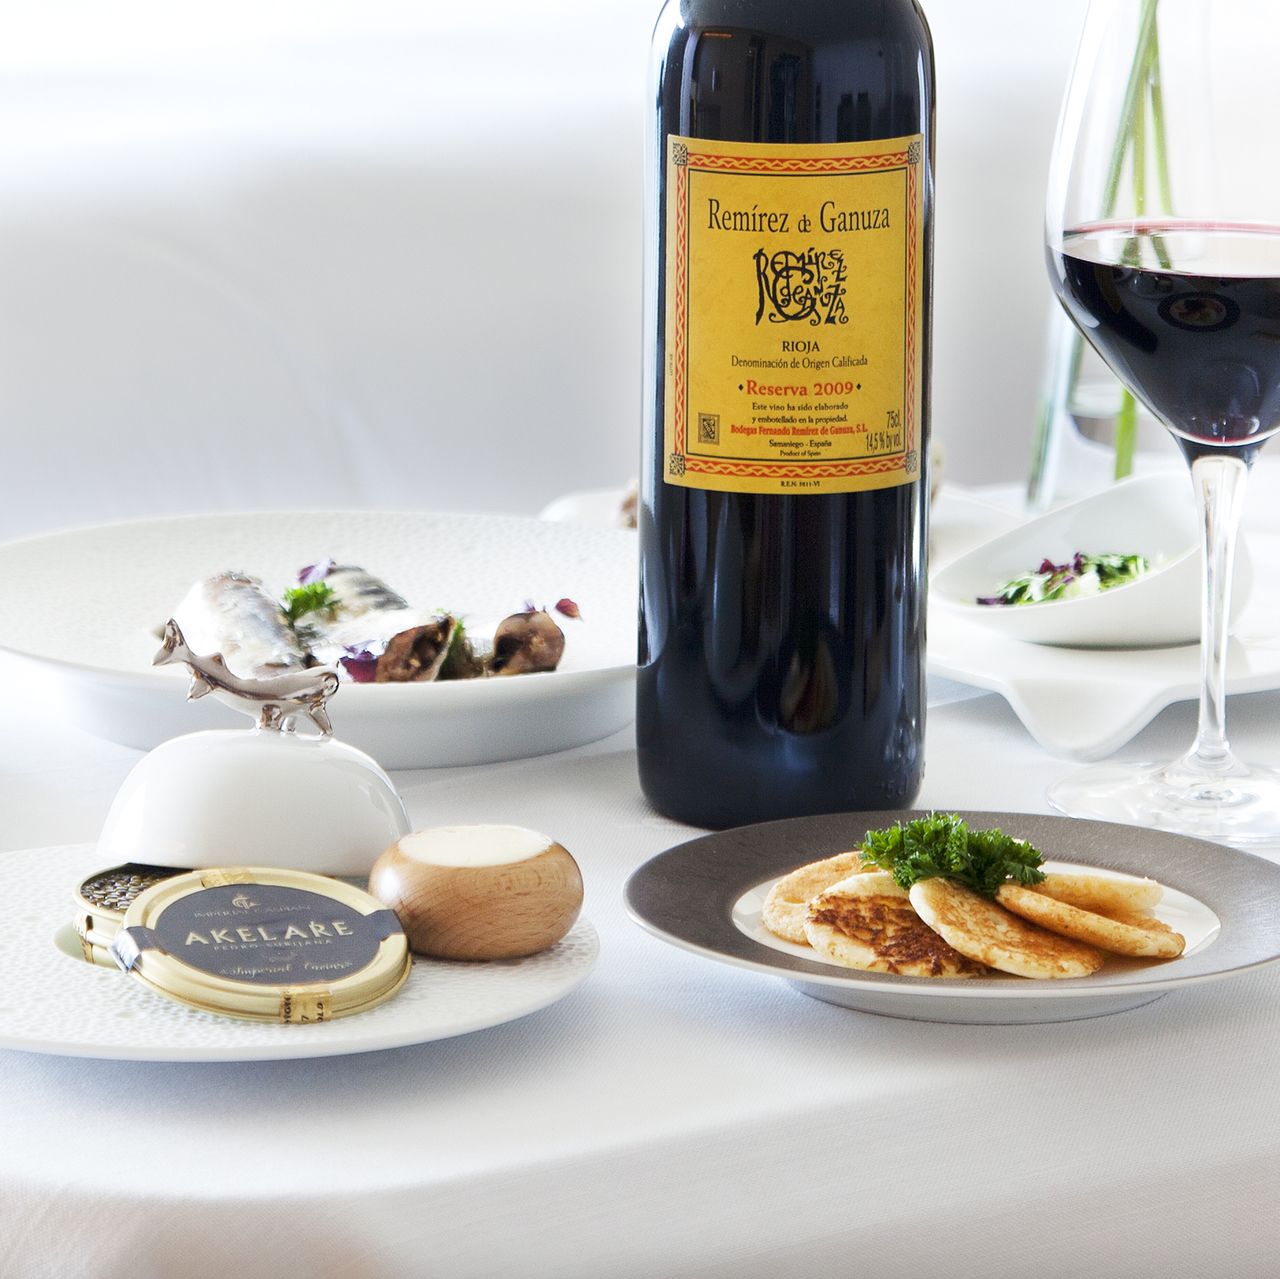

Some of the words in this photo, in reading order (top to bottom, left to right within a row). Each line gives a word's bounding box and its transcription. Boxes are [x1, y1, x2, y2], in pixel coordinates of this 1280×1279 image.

[708, 198, 789, 233] Remírez
[797, 214, 812, 233] de
[820, 201, 890, 233] Ganuza
[782, 340, 820, 354] RIOJA
[731, 355, 788, 369] Denominación
[790, 357, 800, 369] de
[802, 358, 830, 370] Origen
[832, 355, 868, 368] Calificada
[746, 380, 807, 396] Reserva
[813, 382, 854, 396] 2009
[752, 402, 767, 411] Este
[769, 403, 785, 412] vino
[787, 403, 796, 411] ha
[798, 403, 812, 411] sido
[814, 402, 848, 411] elaborado
[757, 415, 797, 424] embotellado
[808, 415, 814, 423] la
[730, 424, 757, 436] Bodegas
[760, 425, 790, 436] Fernando
[820, 425, 829, 435] de
[769, 439, 804, 449] Samaniego
[809, 439, 832, 448] España
